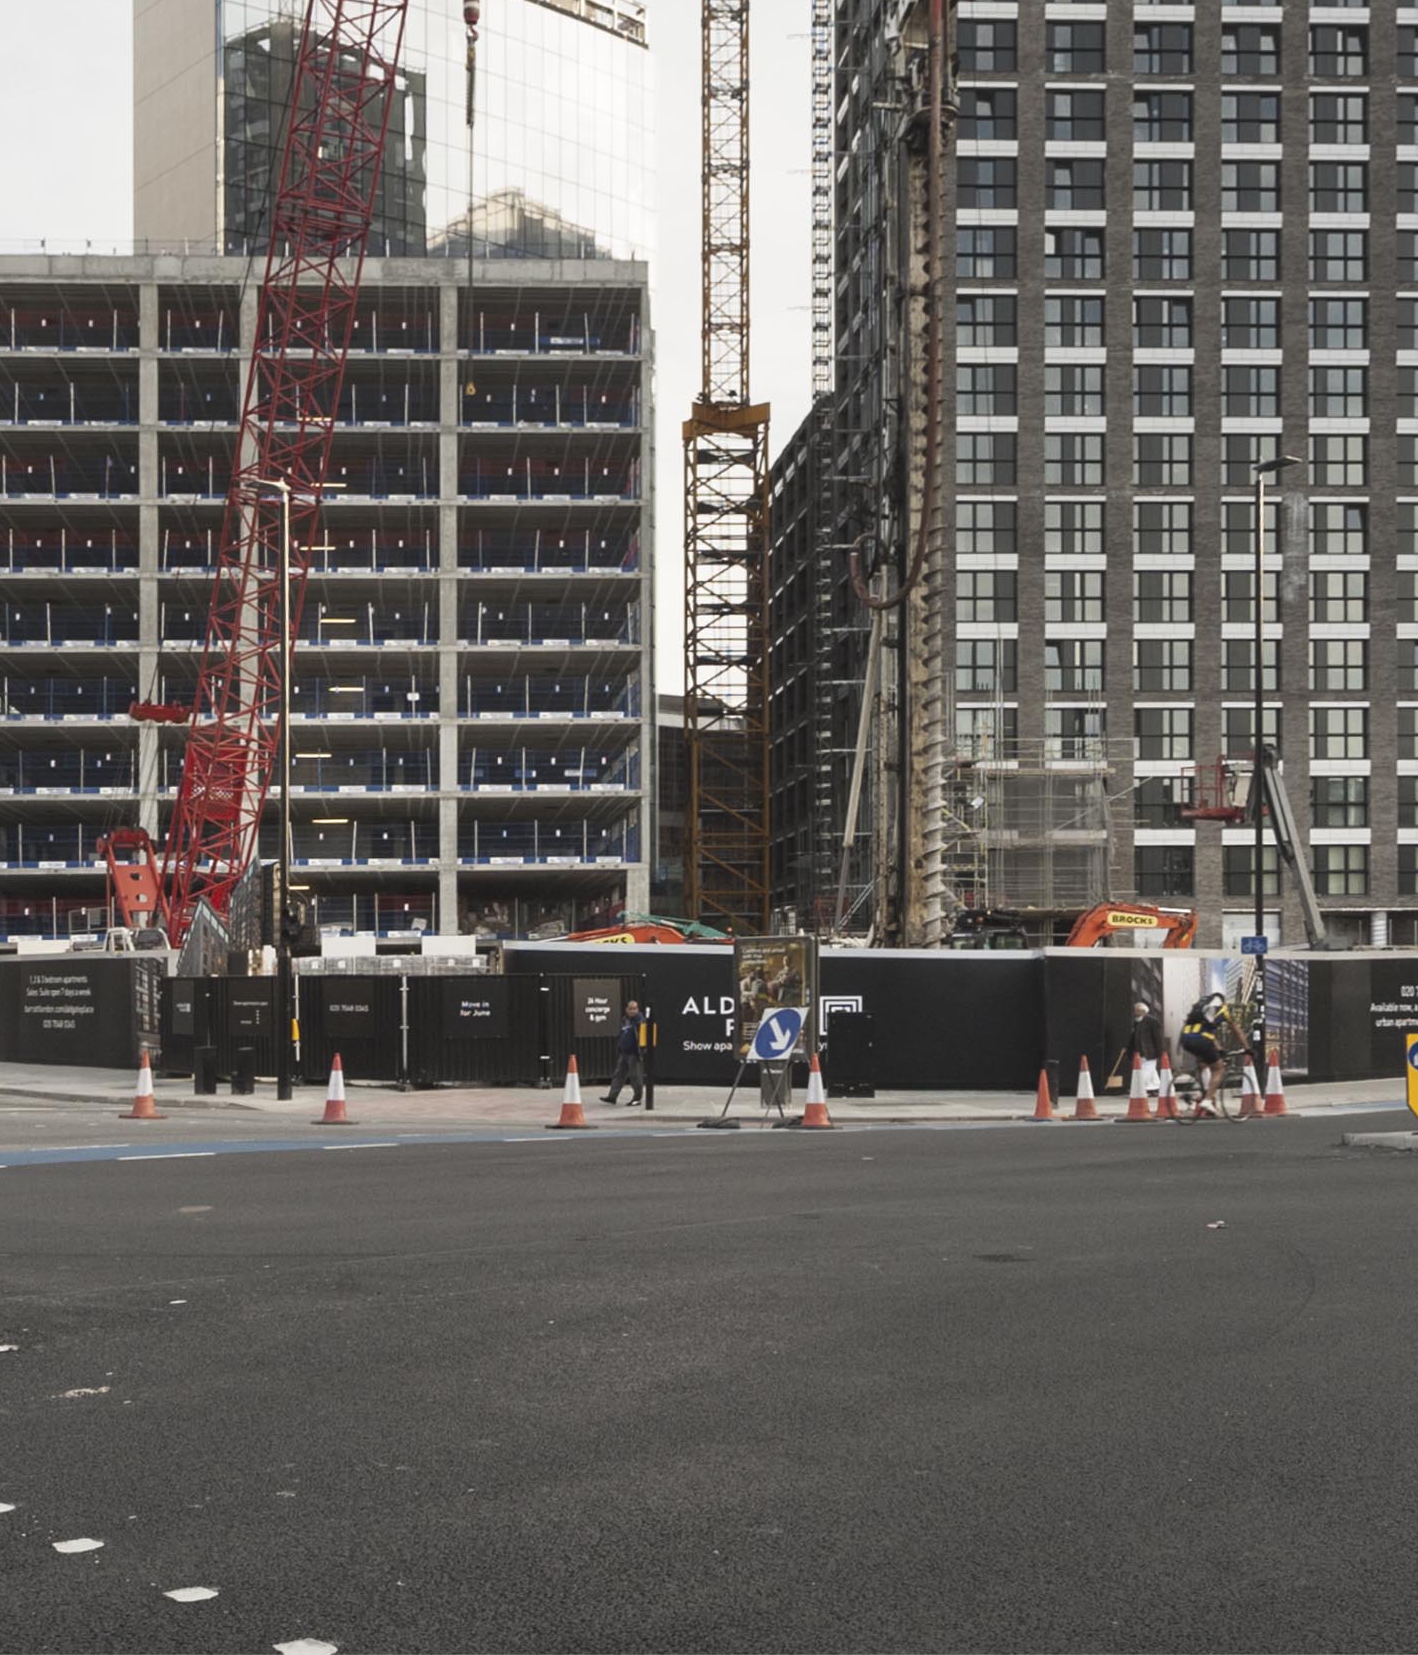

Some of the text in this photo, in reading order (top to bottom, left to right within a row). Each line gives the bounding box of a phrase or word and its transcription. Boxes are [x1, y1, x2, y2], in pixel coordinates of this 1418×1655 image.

[1112, 914, 1153, 925] BROCKS
[461, 1000, 490, 1008] Move in
[1370, 1002, 1398, 1012] Available
[460, 1009, 491, 1017] for June
[1376, 1016, 1394, 1027] urban
[683, 1040, 710, 1051] Show
